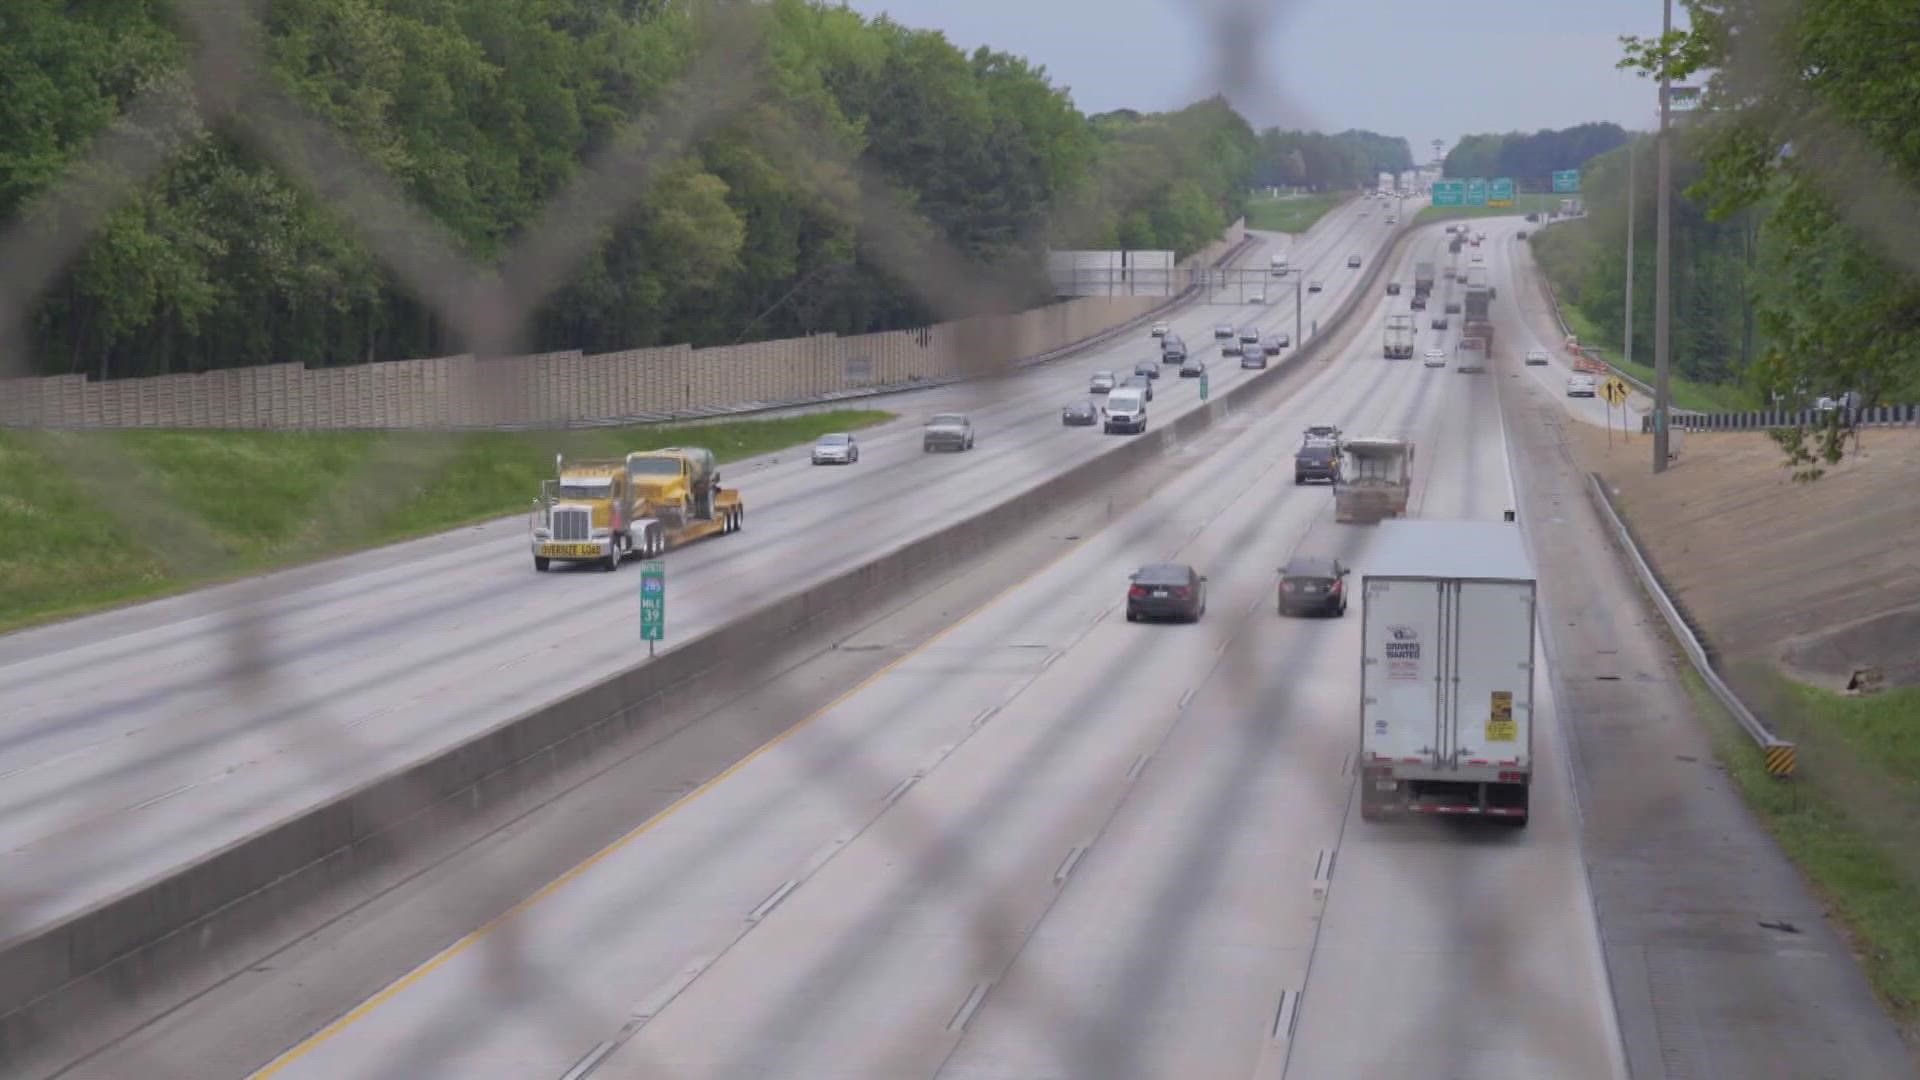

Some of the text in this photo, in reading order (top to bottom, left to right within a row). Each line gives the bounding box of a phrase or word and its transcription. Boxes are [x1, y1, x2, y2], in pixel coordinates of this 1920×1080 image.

[581, 544, 600, 554] LOAD
[642, 599, 660, 609] MILE
[644, 608, 659, 621] 39
[1386, 651, 1420, 659] WANTED
